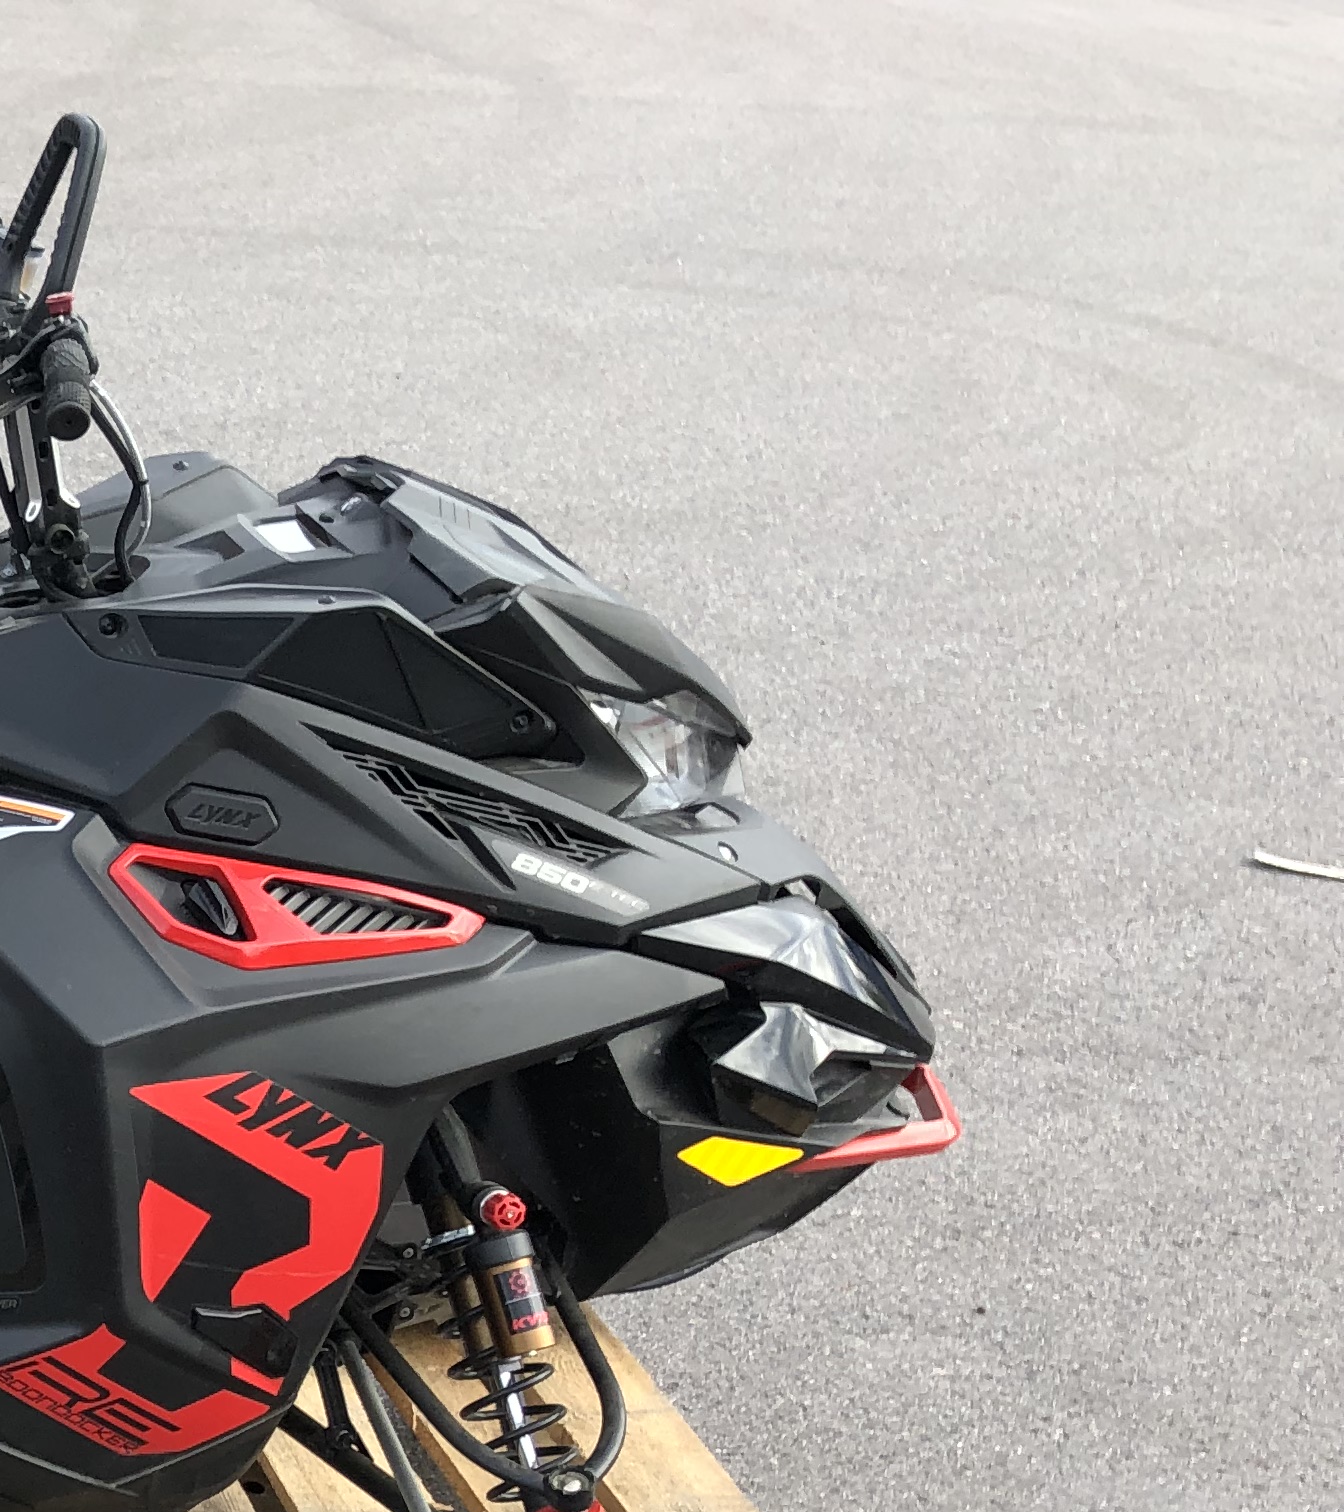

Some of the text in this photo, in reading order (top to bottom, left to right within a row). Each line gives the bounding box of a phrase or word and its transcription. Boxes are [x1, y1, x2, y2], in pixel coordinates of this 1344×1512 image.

[186, 803, 262, 829] LYNX
[511, 852, 590, 895] 850
[202, 1071, 383, 1172] LYNX
